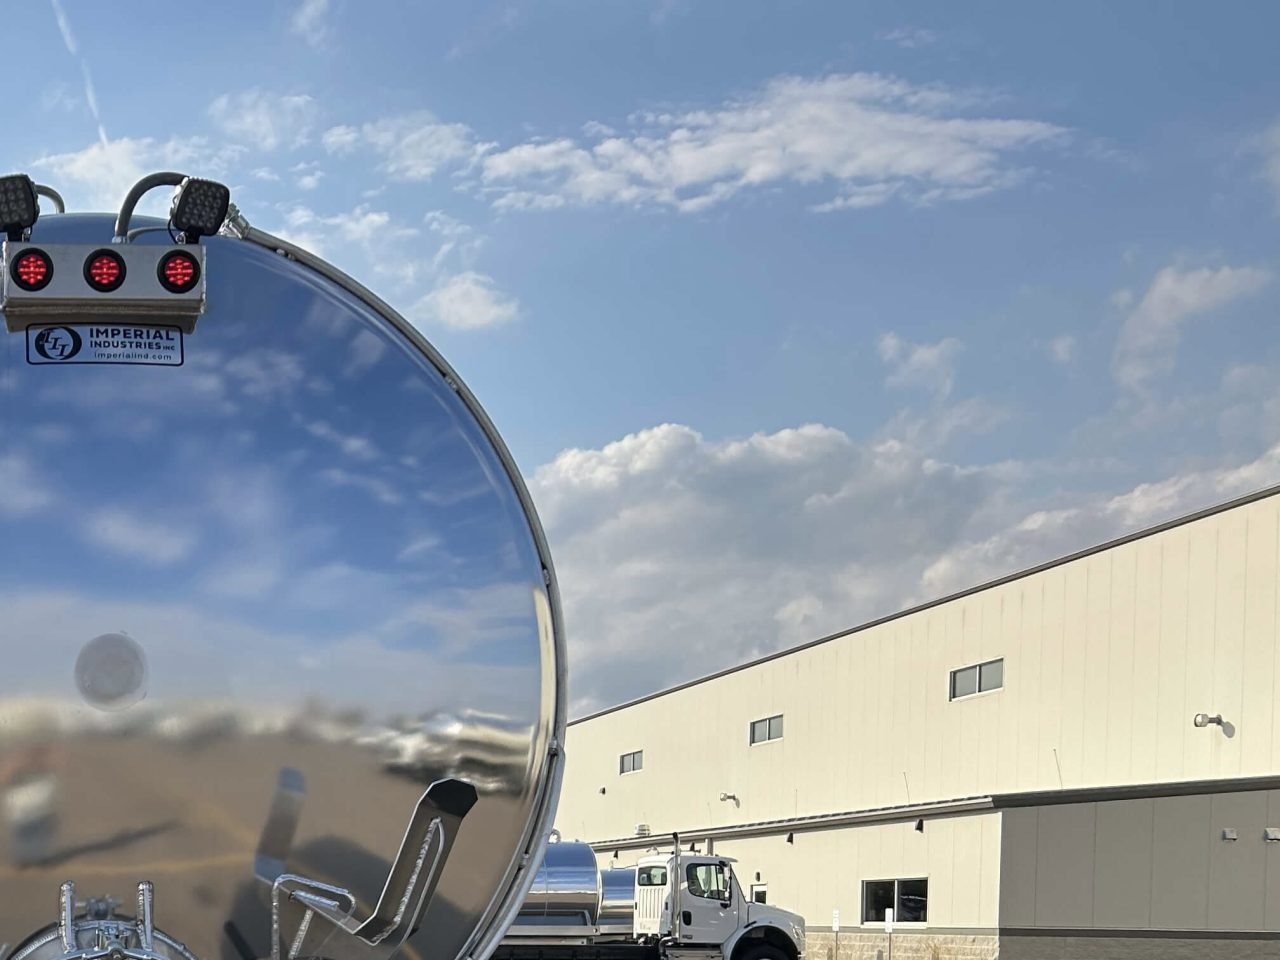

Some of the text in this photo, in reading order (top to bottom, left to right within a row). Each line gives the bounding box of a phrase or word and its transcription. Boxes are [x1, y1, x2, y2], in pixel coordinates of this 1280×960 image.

[89, 327, 175, 341] IMPERIAL
[90, 340, 161, 350] INDUSTRIES
[94, 352, 172, 361] imperialind.com
